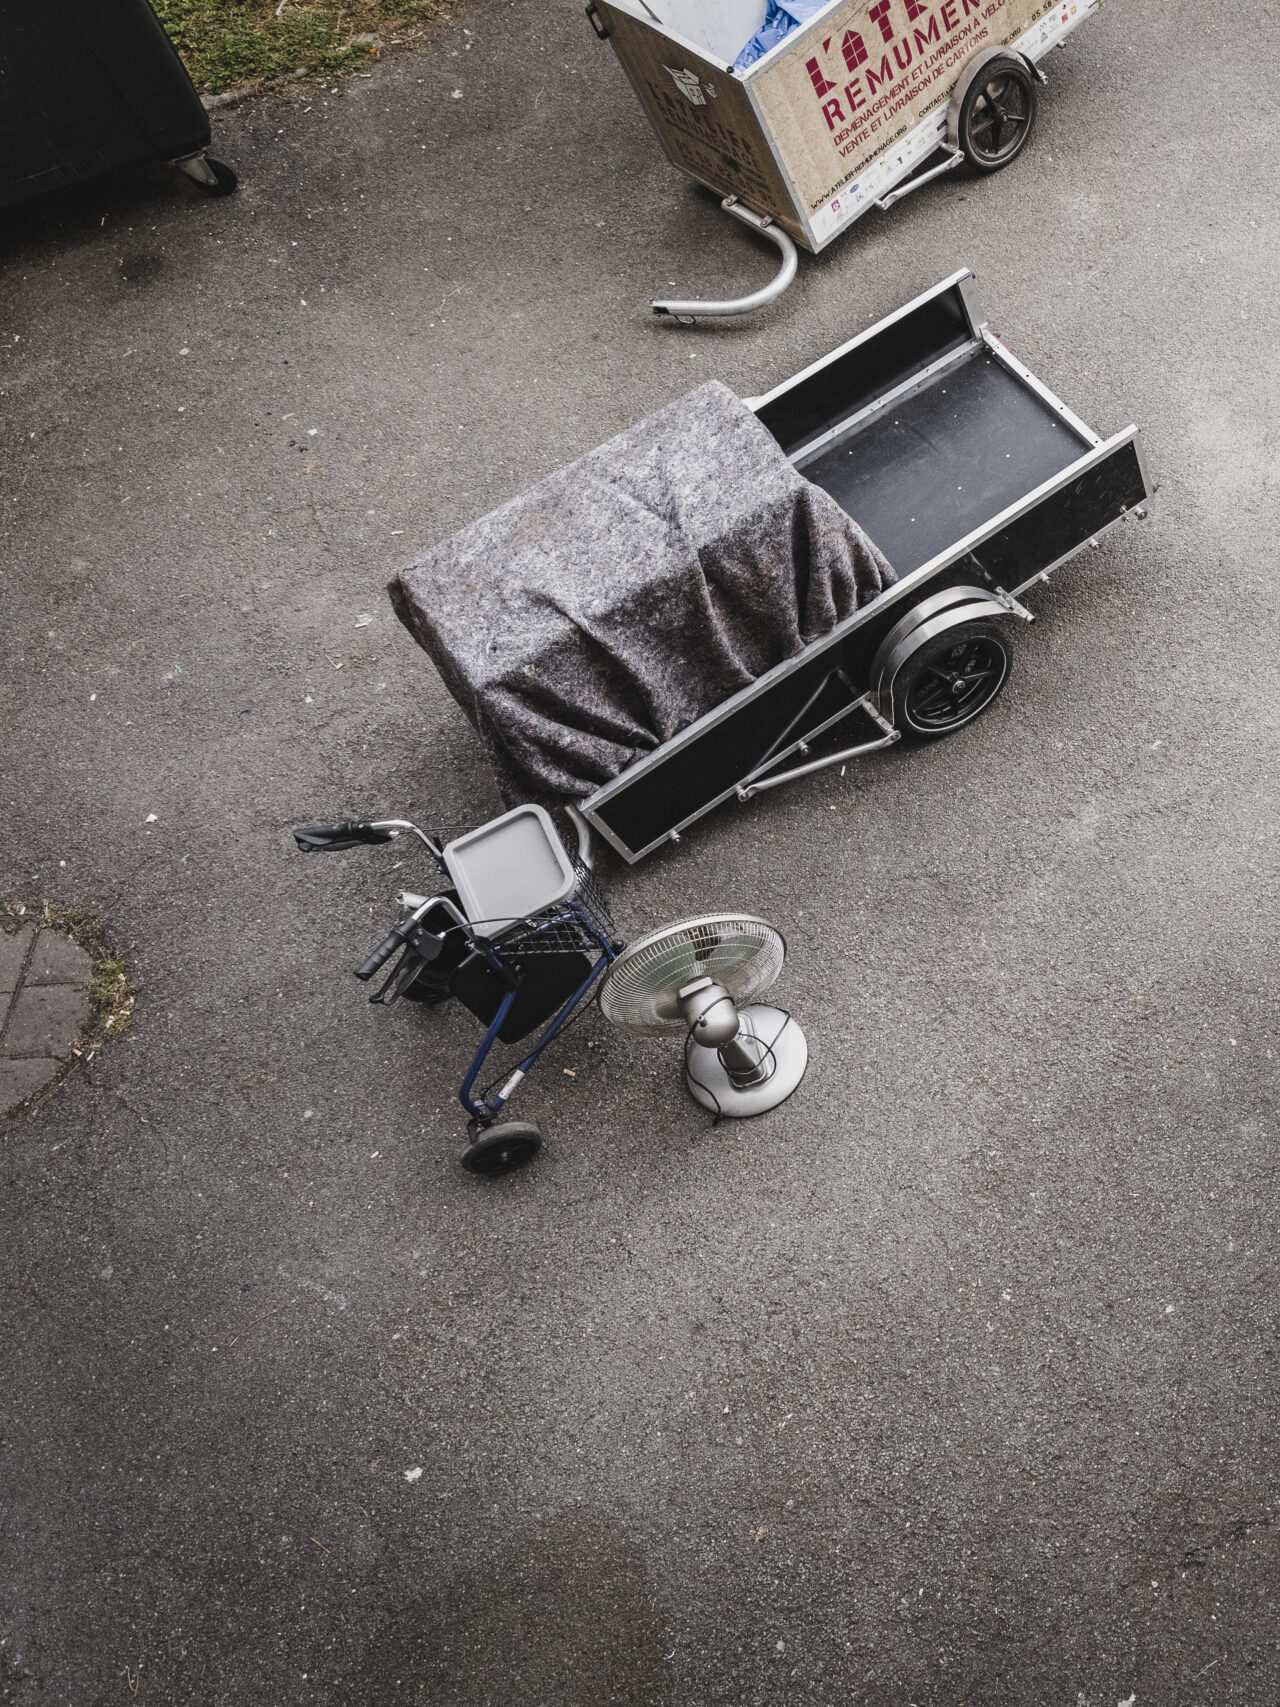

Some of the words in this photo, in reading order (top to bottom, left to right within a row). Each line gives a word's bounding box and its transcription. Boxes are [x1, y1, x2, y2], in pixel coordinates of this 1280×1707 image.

[838, 131, 870, 158] VENTE
[870, 120, 883, 138] ET
[884, 76, 932, 121] LIVRAISON
[932, 64, 946, 82] DE
[945, 27, 989, 69] CARTONS
[911, 64, 925, 83] ET
[925, 23, 972, 71] LIVRAISON
